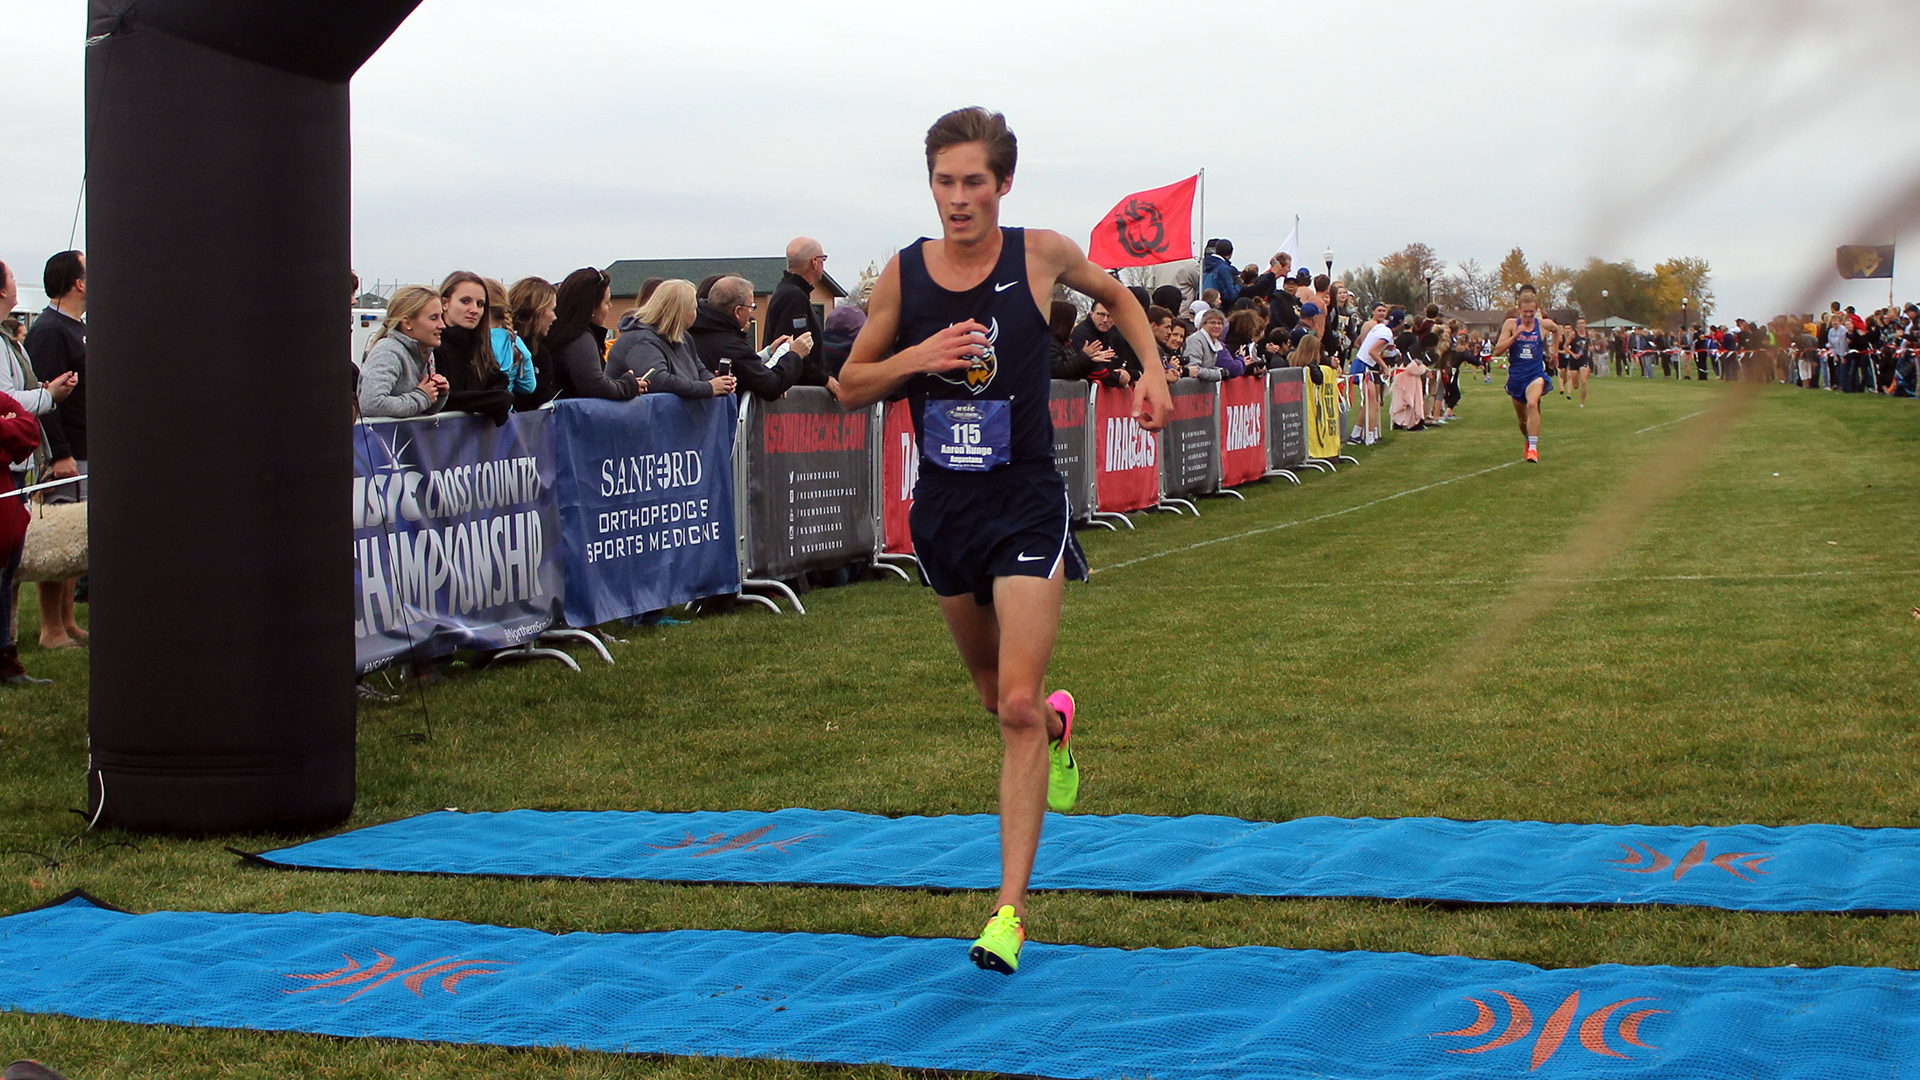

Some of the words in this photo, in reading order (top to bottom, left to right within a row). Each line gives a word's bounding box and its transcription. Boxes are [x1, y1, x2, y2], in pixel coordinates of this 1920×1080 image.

[941, 444, 964, 454] Aaron
[965, 445, 992, 456] Runge
[950, 423, 981, 444] 115
[425, 464, 473, 519] CROSS
[475, 456, 542, 511] COUNTRY
[601, 449, 703, 497] SANFORD
[598, 499, 709, 533] ORTHOPEDICS
[586, 534, 644, 563] SPORTS
[649, 521, 720, 551] MEDICNE
[353, 510, 544, 639] HAMPIONSHIP
